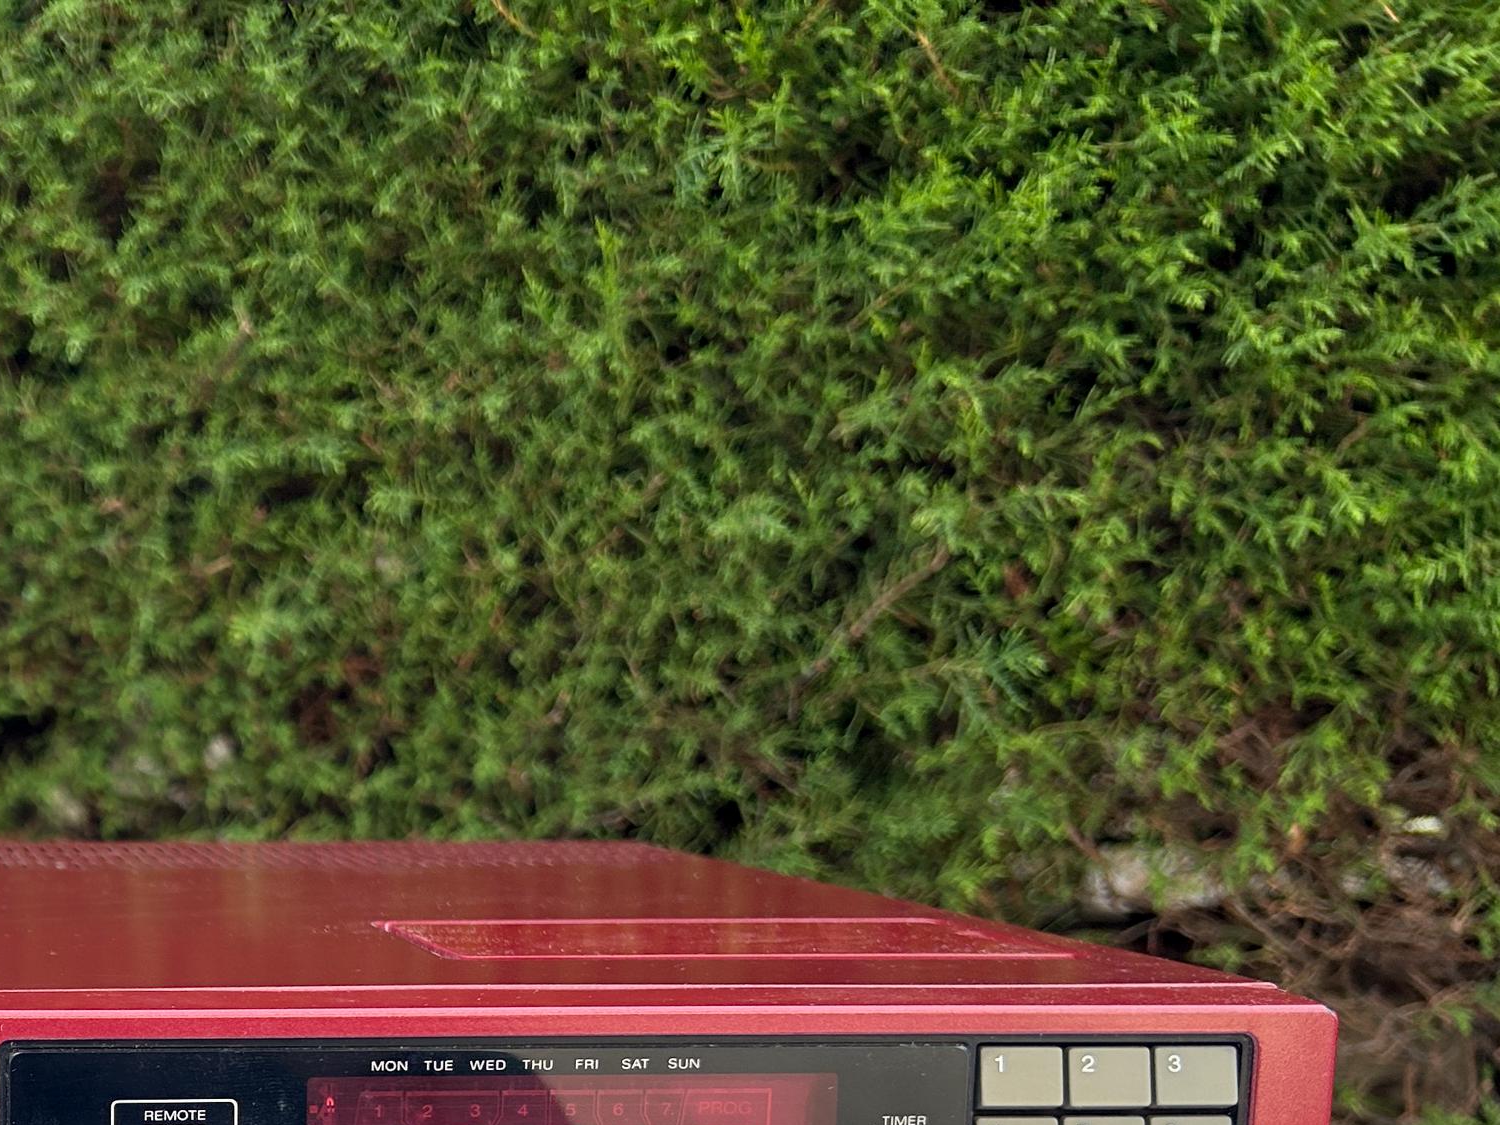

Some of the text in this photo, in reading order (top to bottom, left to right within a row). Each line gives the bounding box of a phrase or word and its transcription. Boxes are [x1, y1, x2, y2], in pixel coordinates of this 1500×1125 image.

[371, 1058, 701, 1071] MON TUE WED THU FRI SAT SUN
[994, 1054, 1182, 1073] 1 2 3
[144, 1110, 206, 1121] REMOTE
[374, 1105, 383, 1117] 1
[422, 1105, 433, 1118] 2
[470, 1105, 481, 1117] 3
[517, 1105, 528, 1117] 4
[565, 1104, 576, 1116] 5
[612, 1103, 624, 1116] 6
[698, 1102, 752, 1115] PROG
